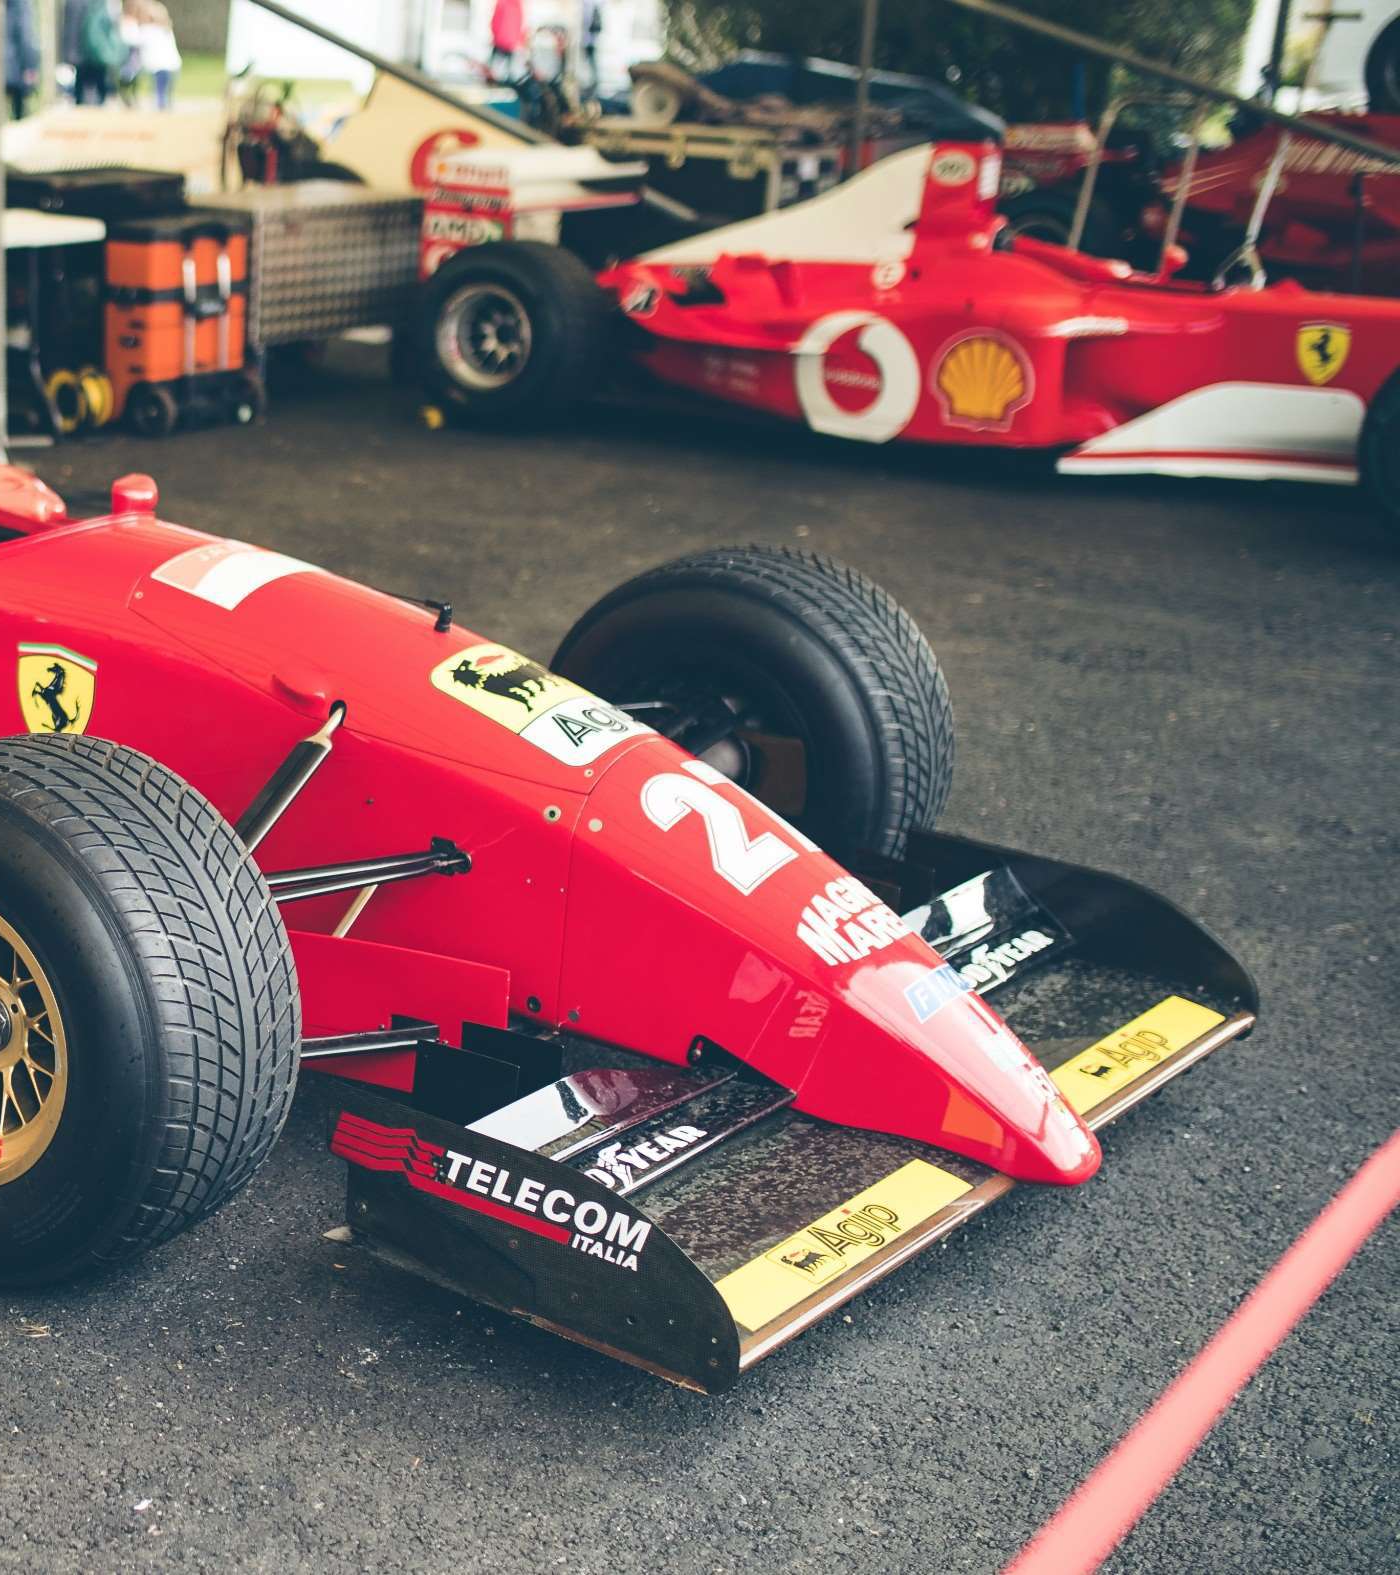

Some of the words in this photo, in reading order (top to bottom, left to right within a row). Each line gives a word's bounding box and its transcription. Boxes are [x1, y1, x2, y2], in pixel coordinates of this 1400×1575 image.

[552, 706, 630, 747] Ag
[1095, 1030, 1171, 1069] Agip
[583, 1124, 708, 1189] DYEAR
[445, 1150, 652, 1253] TELECOM
[571, 1233, 639, 1272] ITALIA
[806, 1204, 902, 1257] Agip
